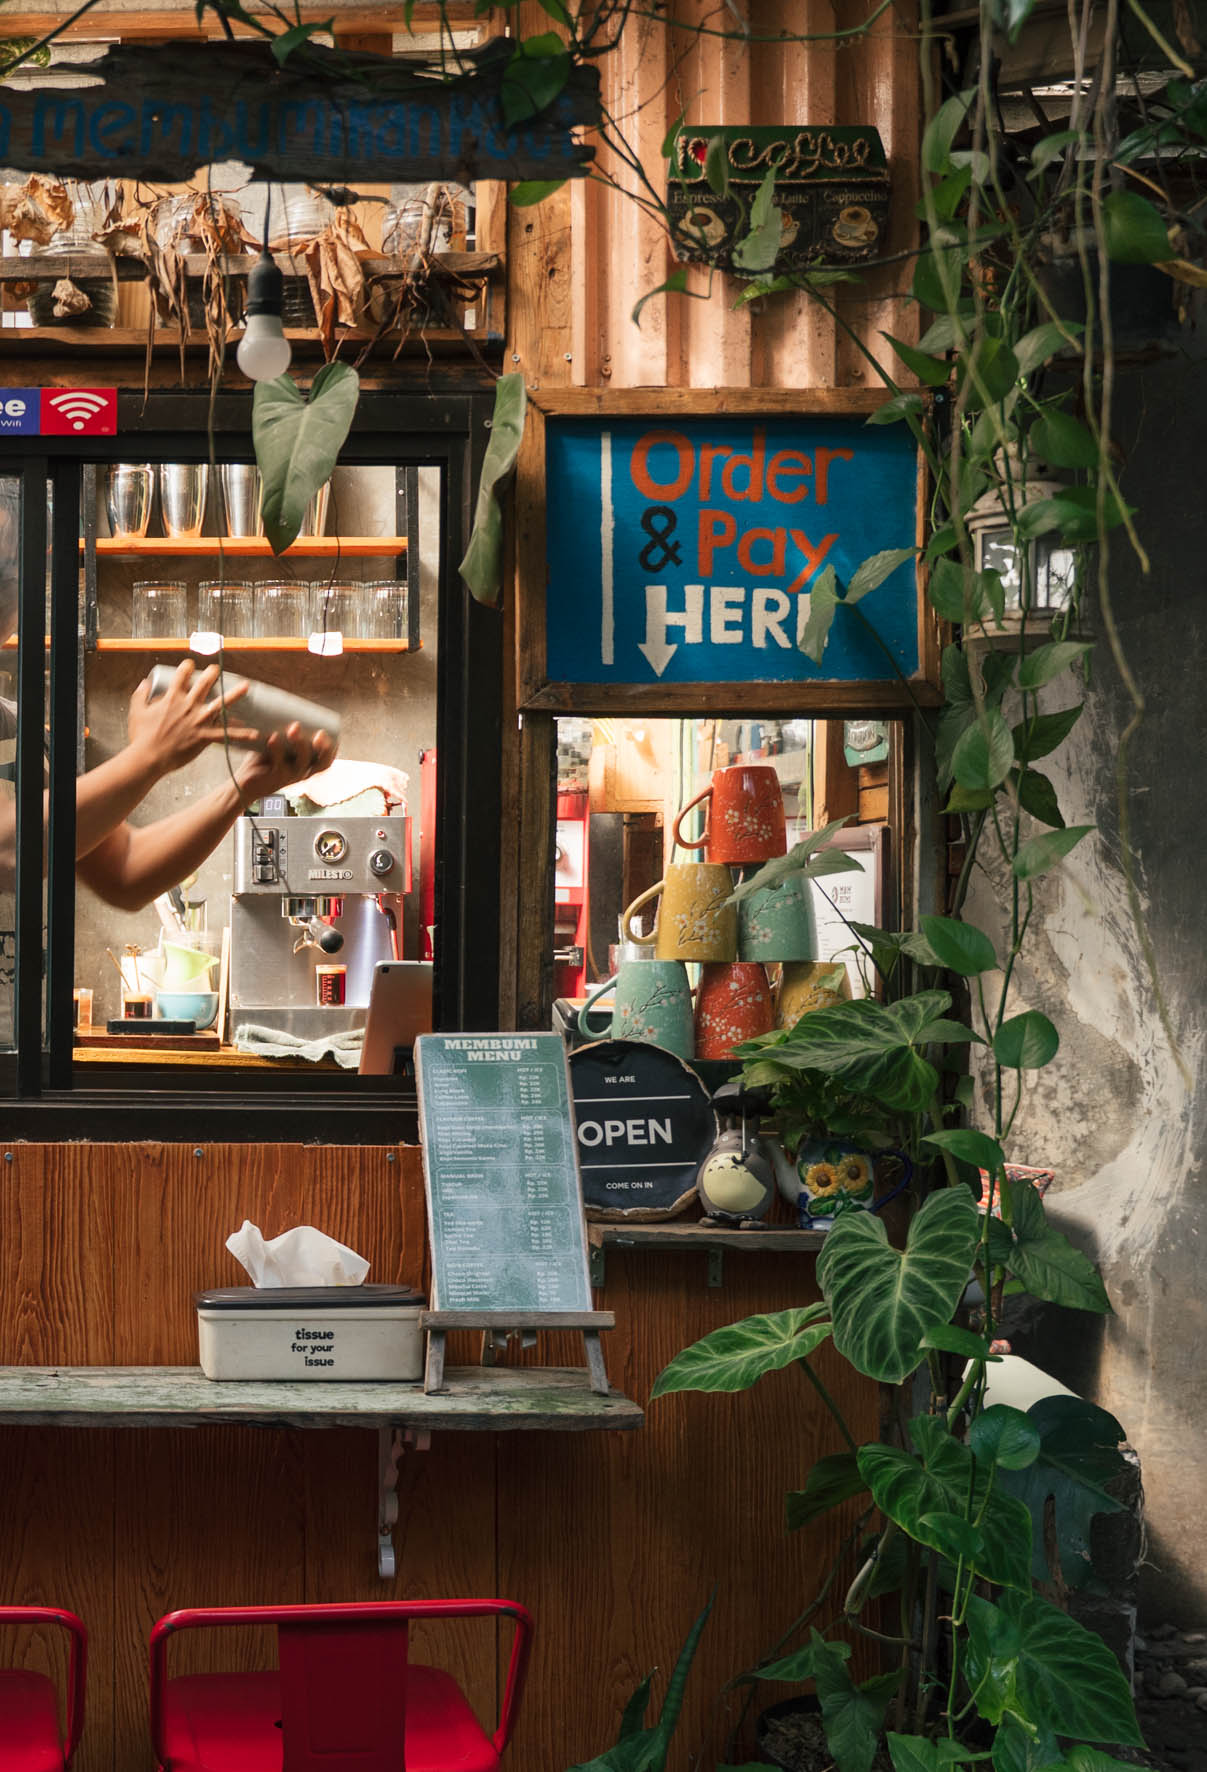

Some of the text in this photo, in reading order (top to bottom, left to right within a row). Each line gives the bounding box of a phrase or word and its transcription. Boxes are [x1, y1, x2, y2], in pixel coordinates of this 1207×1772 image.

[629, 424, 855, 506] Order
[638, 505, 841, 594] & Pay
[444, 1038, 538, 1050] MEMBUMI
[467, 1050, 522, 1062] MENU
[604, 1075, 637, 1084] WE ARE
[577, 1117, 673, 1147] OPEN
[606, 1182, 630, 1190] COME
[631, 1181, 643, 1189] ON
[295, 1327, 335, 1341] tissue
[291, 1342, 334, 1355] for your
[304, 1356, 335, 1368] issue
